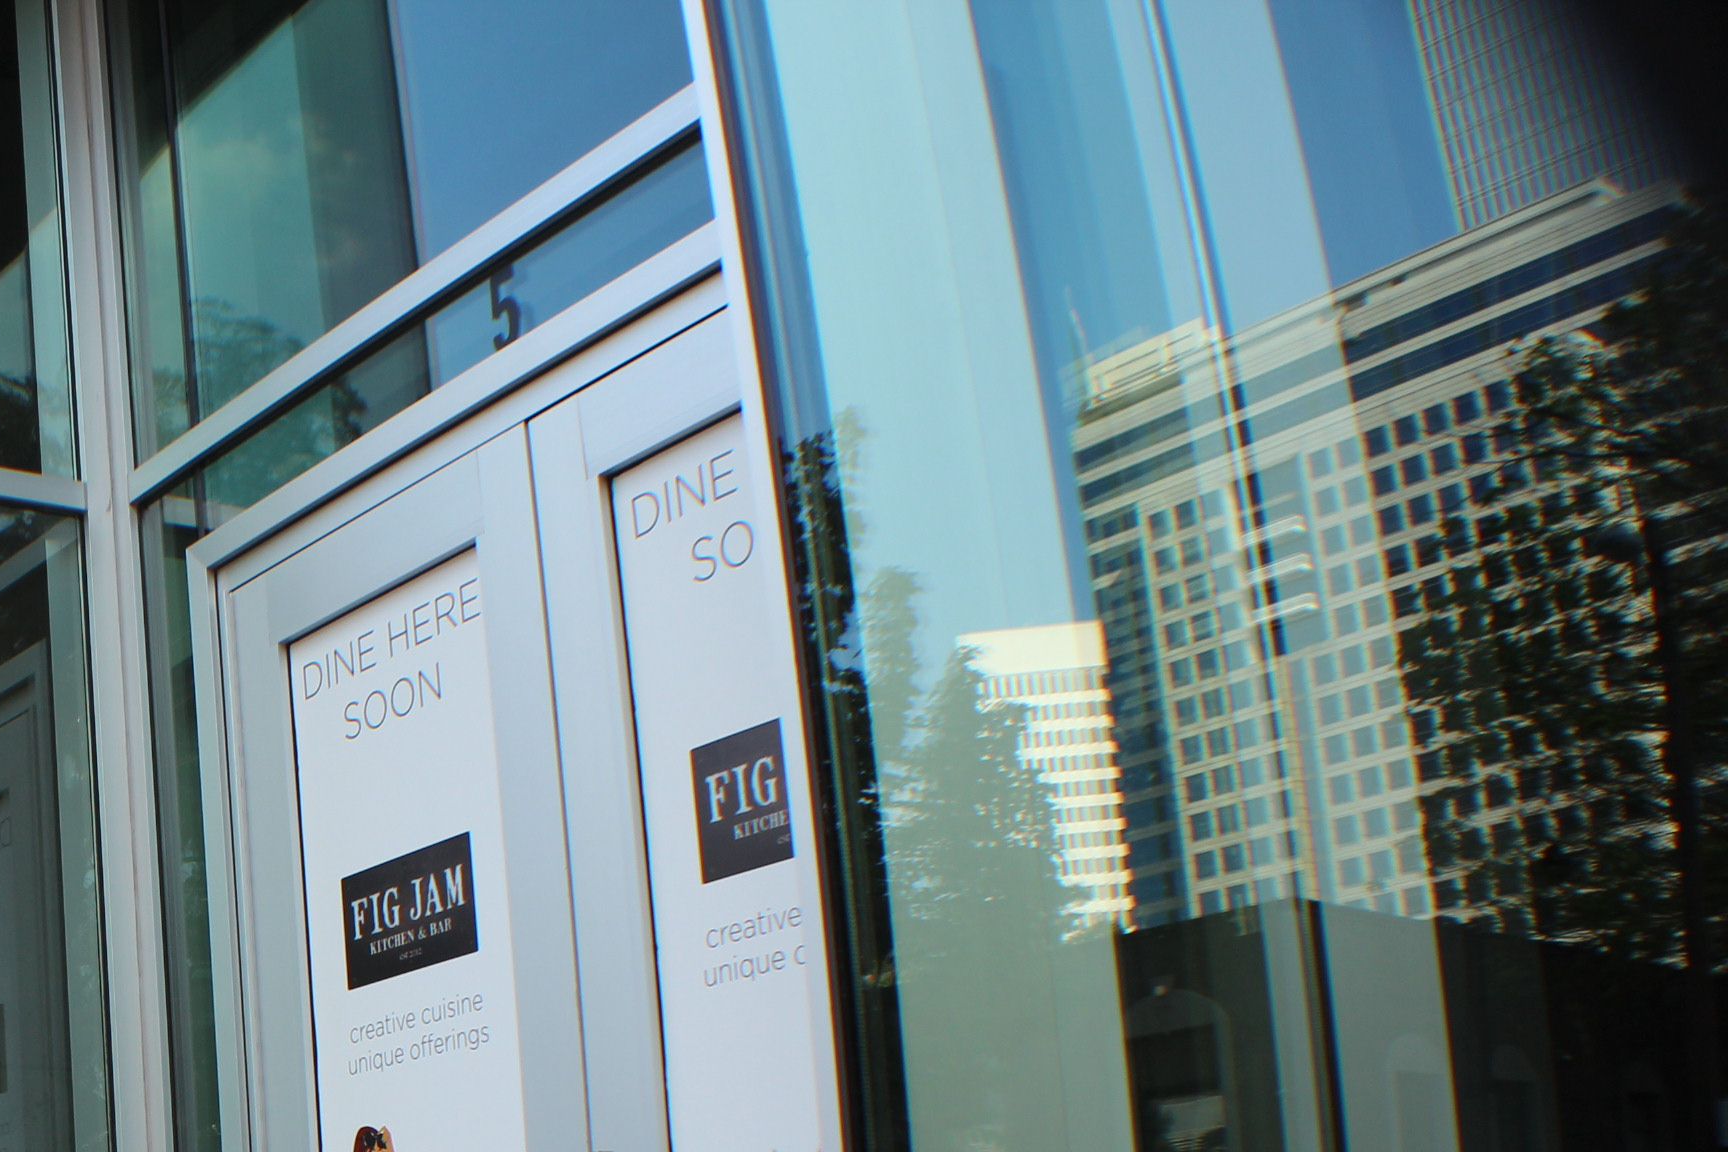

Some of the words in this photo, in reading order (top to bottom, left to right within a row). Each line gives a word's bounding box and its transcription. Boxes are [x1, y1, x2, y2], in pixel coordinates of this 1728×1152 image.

[488, 264, 521, 352] 5
[631, 449, 739, 539] DINE
[692, 520, 754, 582] SO
[303, 629, 378, 700] DINE
[388, 577, 482, 658] HERE
[344, 662, 442, 740] SOON
[705, 755, 779, 824] FIG
[733, 809, 790, 840] KITCHE
[351, 886, 401, 941] FIG
[410, 863, 466, 921] JAM
[705, 906, 802, 949] creative
[369, 929, 415, 956] KITCHEN
[417, 925, 427, 940] &
[429, 917, 453, 937] BAR
[703, 950, 786, 987] unique
[349, 1011, 416, 1044] creative
[421, 993, 484, 1025] cuisine
[348, 1049, 404, 1076] unique
[409, 1025, 491, 1060] offerings
